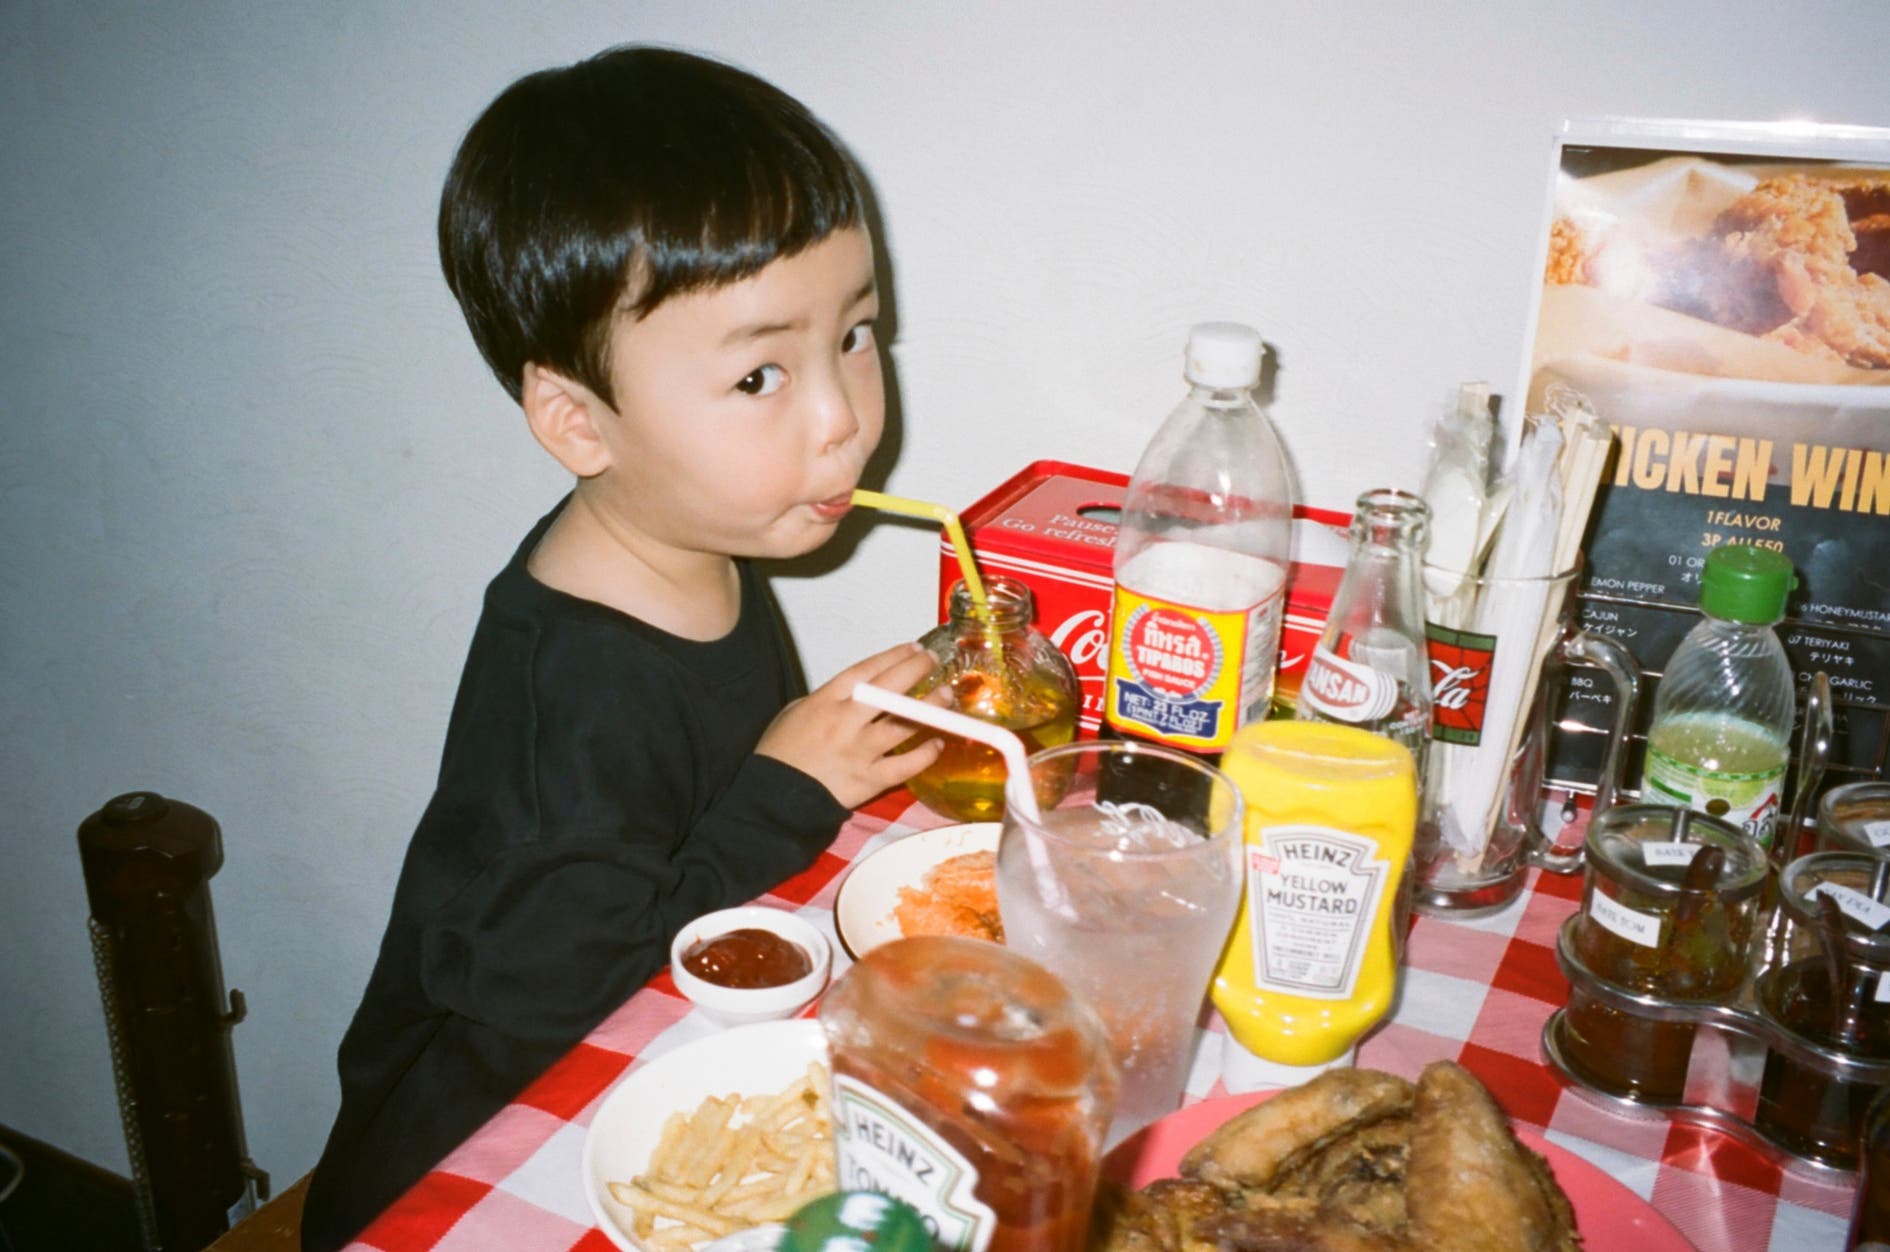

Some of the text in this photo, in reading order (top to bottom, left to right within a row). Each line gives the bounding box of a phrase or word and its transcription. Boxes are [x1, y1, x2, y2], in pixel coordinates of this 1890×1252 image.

[1002, 517, 1036, 532] Go
[1701, 533, 1722, 547] 3P
[1804, 636, 1850, 651] TERIYAKI
[1308, 663, 1367, 704] ANSAN
[1571, 676, 1593, 689] BBQ
[1568, 691, 1613, 705] バーベキ
[1283, 843, 1352, 867] HEINZ
[1281, 873, 1348, 895] YELLOW
[1267, 887, 1357, 915] MUSTARD
[855, 1111, 935, 1188] HEINZ
